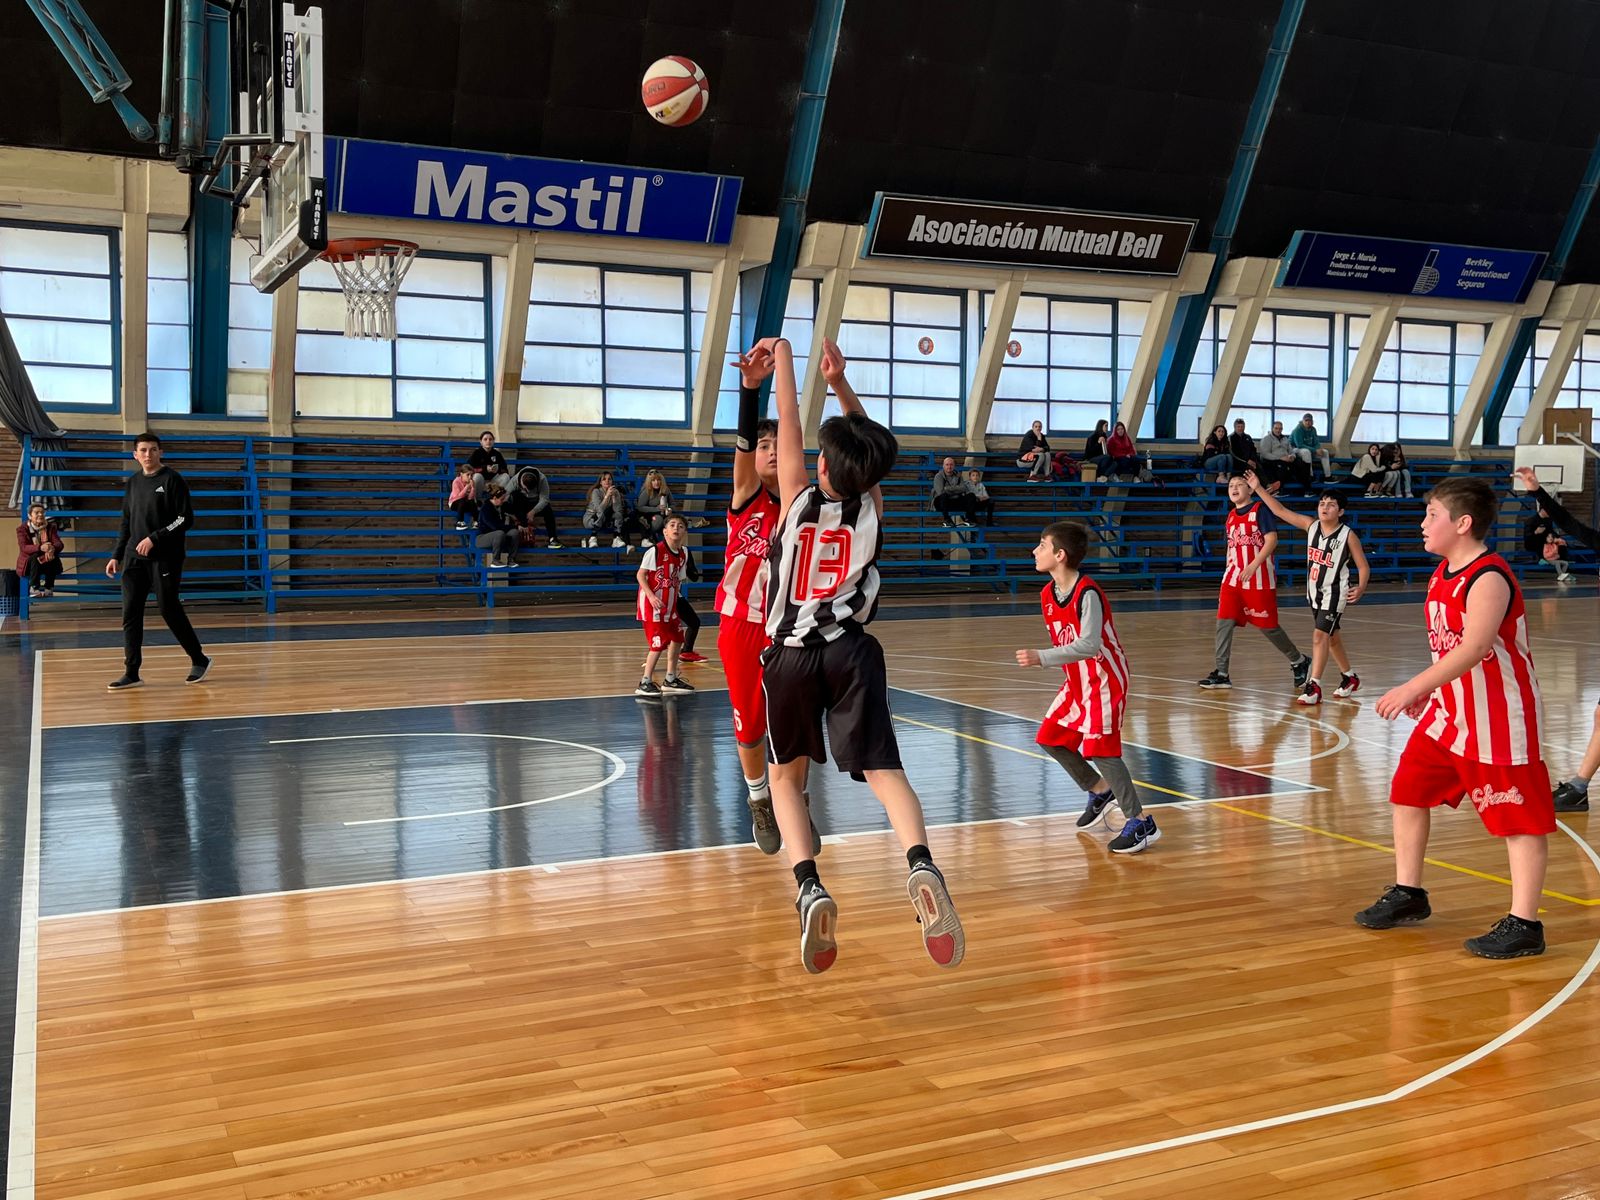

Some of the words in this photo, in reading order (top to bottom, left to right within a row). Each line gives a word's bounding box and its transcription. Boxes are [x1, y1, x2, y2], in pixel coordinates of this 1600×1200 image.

[413, 160, 648, 233] Mastil
[908, 214, 1038, 250] Asociación
[1039, 225, 1119, 256] Mutual
[1117, 231, 1164, 259] Bell
[1332, 250, 1350, 261] Jorge
[1350, 252, 1356, 260] E.
[1329, 261, 1353, 269] Productor
[1465, 257, 1494, 270] Berkley
[1460, 268, 1511, 281] International
[1456, 279, 1486, 290] Seguros
[793, 525, 853, 603] 13
[1308, 547, 1334, 568] BELL
